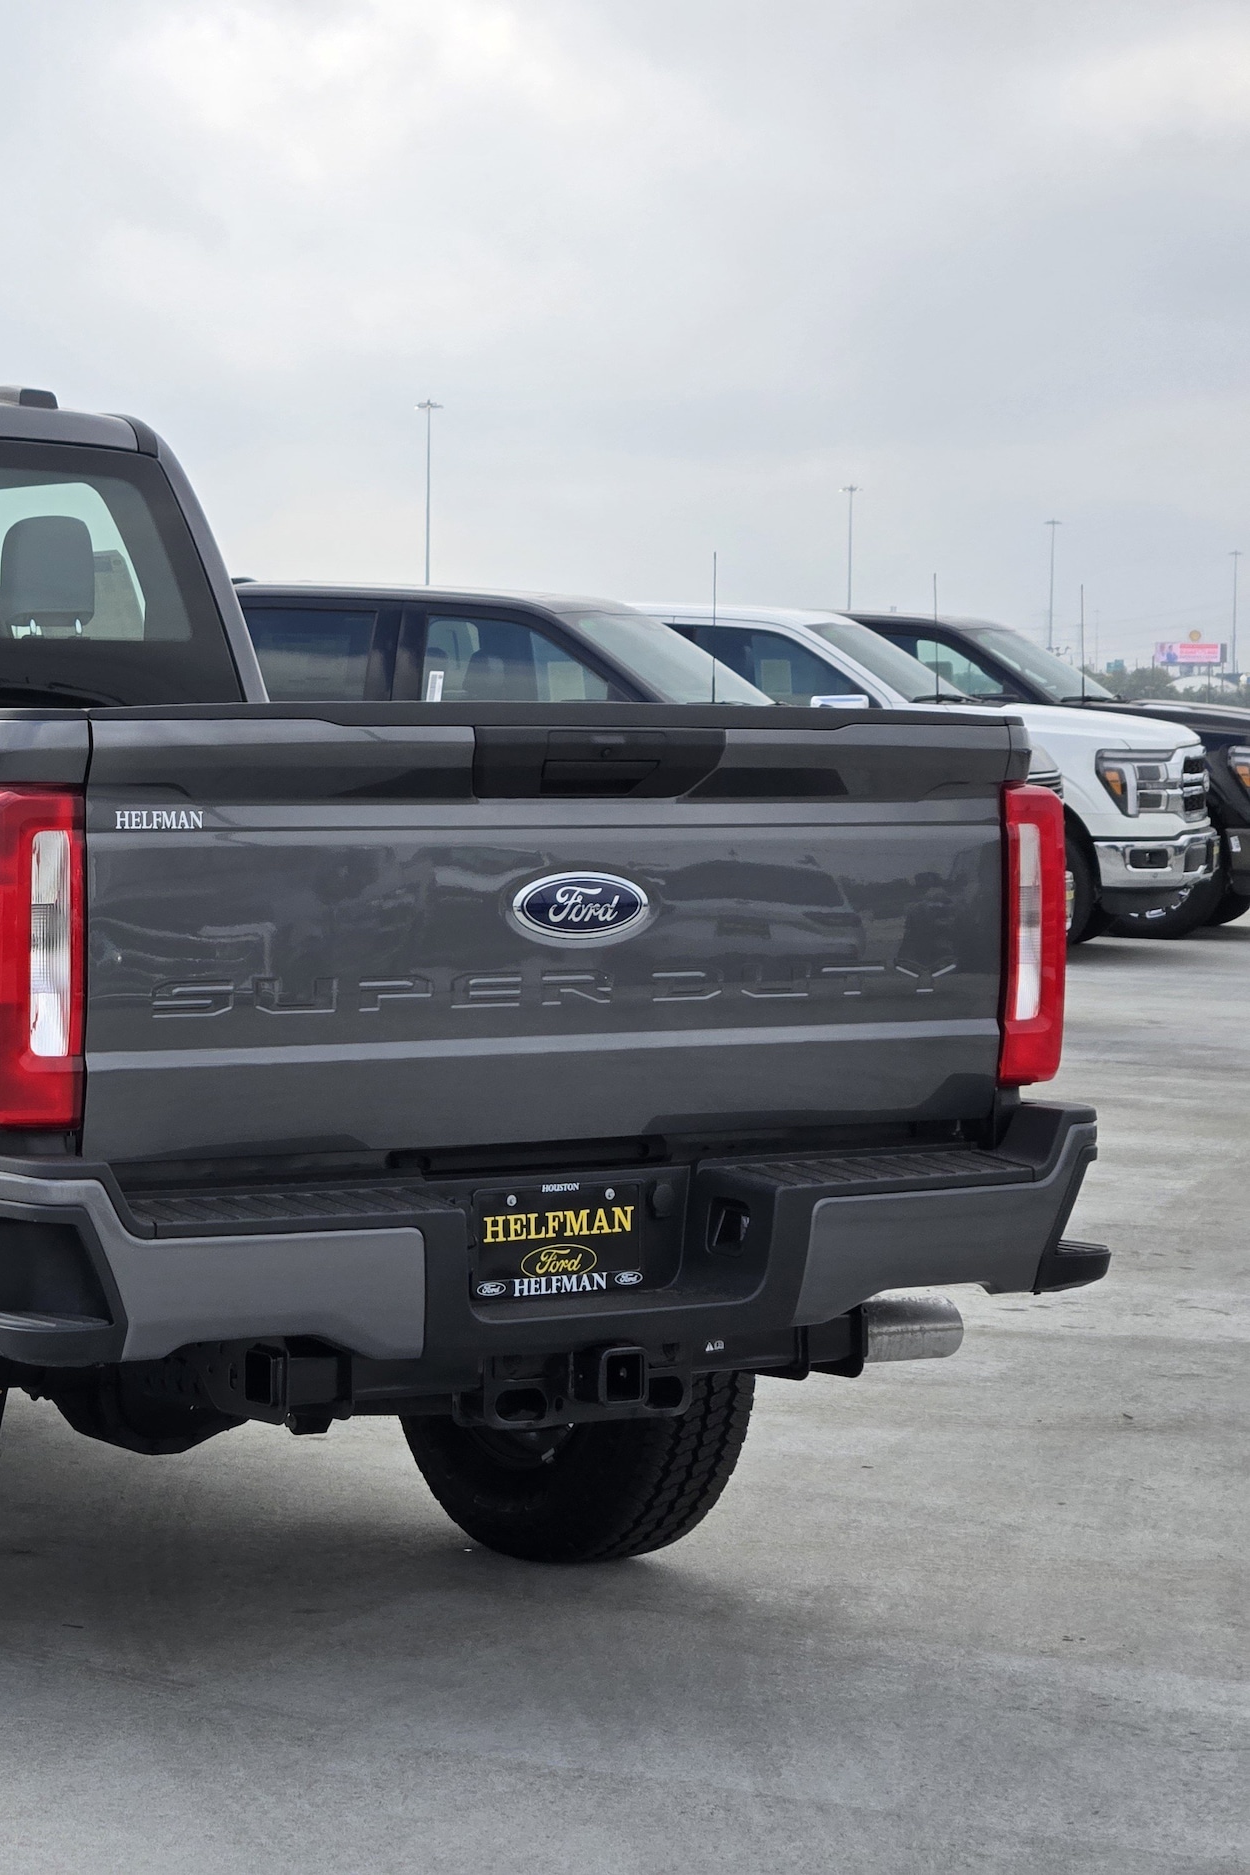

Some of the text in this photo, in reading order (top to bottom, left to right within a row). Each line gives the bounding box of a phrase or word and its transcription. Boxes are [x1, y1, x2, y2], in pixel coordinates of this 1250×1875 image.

[115, 810, 204, 829] HELFMAN
[548, 886, 620, 922] Ford
[151, 957, 957, 1019] SUPER DUTY
[541, 1182, 580, 1193] HOUSTON
[483, 1206, 635, 1243] HELFMAN
[535, 1248, 583, 1274] Ford
[513, 1272, 607, 1297] HELFMAN
